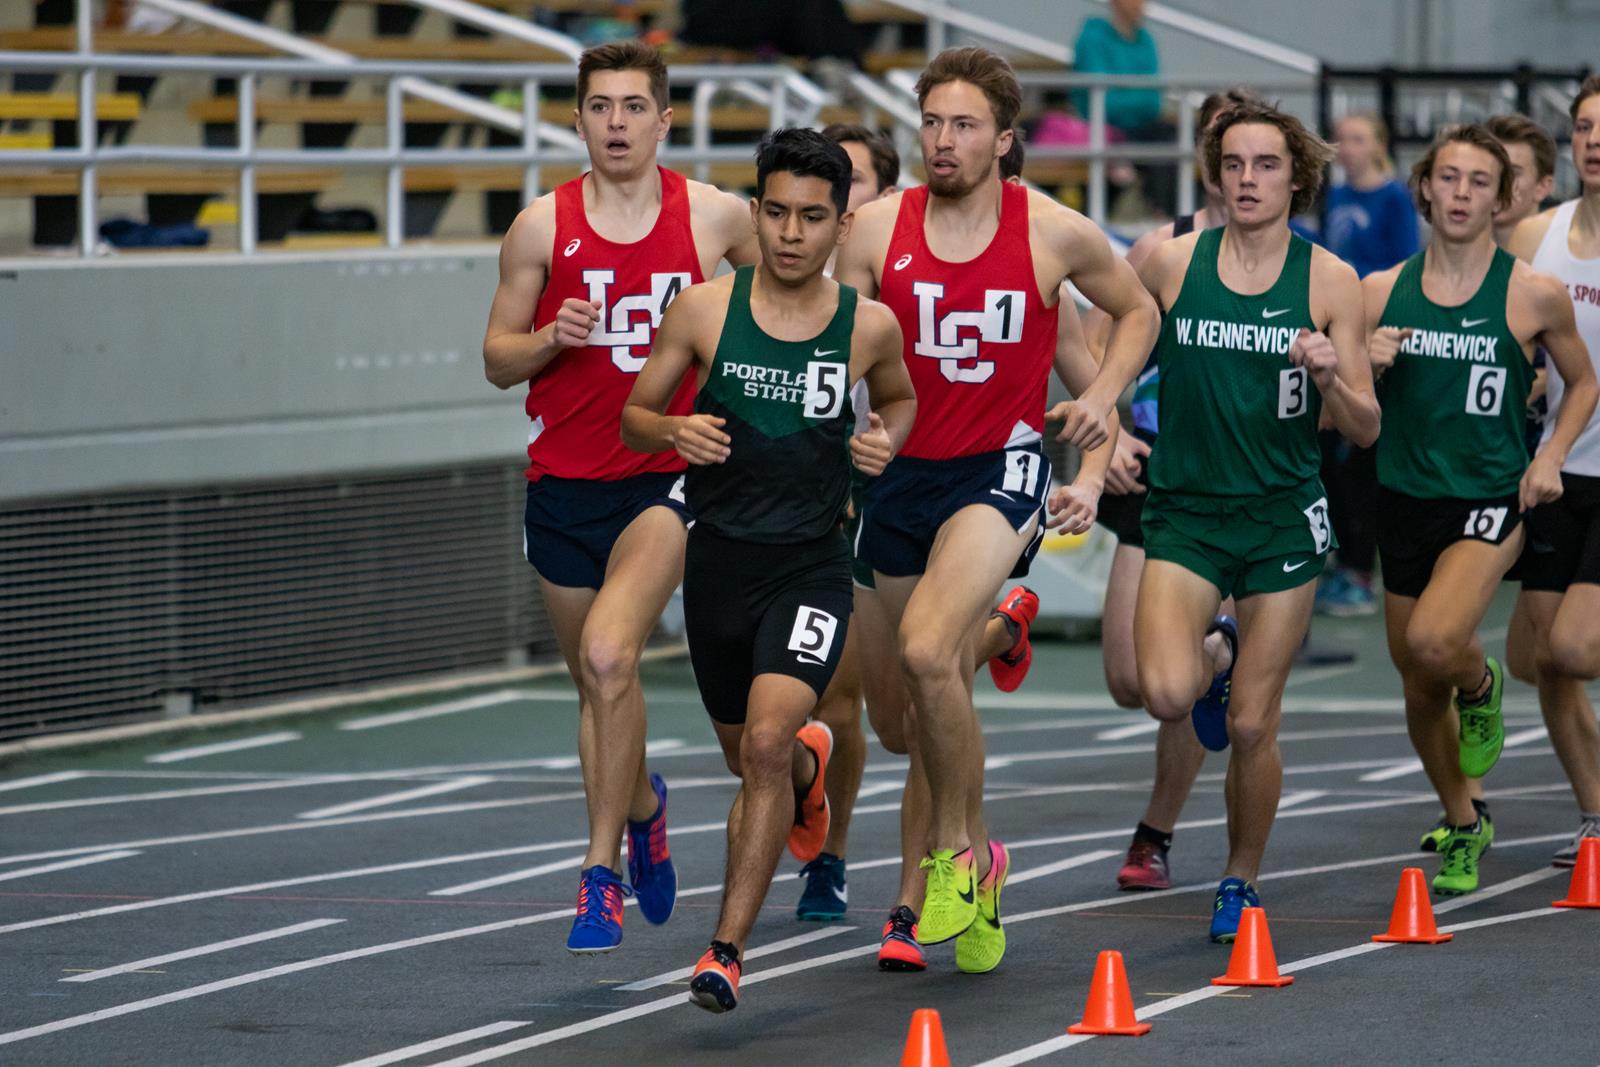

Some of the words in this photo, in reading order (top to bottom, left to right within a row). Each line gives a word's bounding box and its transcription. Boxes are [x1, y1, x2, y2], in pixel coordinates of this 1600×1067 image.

[912, 281, 997, 384] LC
[995, 294, 1012, 340] 1
[1176, 318, 1193, 346] W.
[722, 361, 808, 388] PORTLA
[814, 366, 838, 416] 5
[1286, 370, 1303, 415] 3
[1475, 370, 1498, 413] 6
[1016, 453, 1031, 492] 1
[1311, 505, 1328, 549] 3
[799, 611, 829, 651] 5
